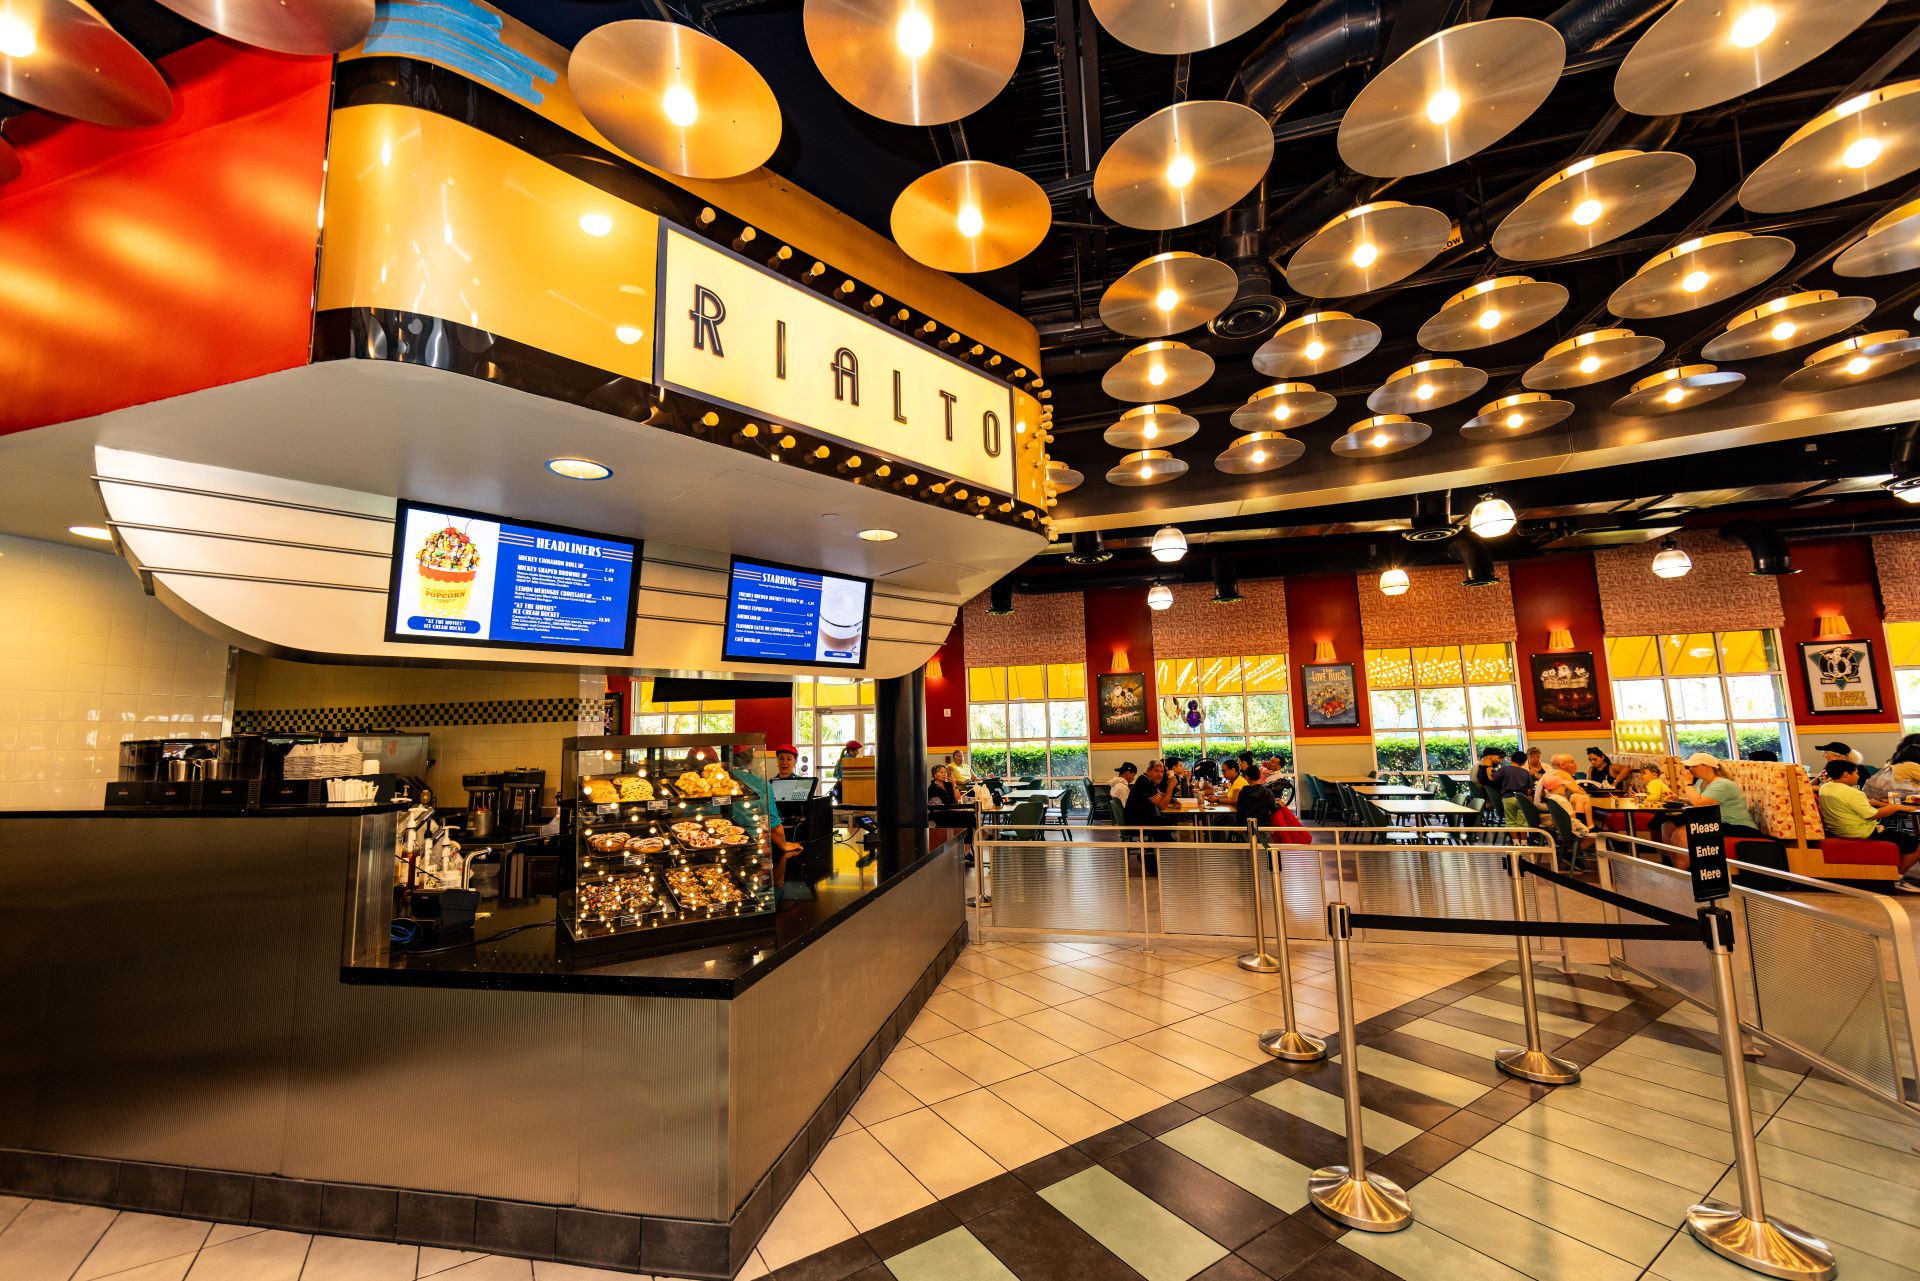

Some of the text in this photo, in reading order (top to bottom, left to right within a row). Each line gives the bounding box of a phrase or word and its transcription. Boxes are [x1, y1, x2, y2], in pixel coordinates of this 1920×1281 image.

[689, 284, 1001, 458] RIALTO
[536, 537, 602, 558] HEADLINERS
[518, 555, 537, 563] MICKEY
[538, 557, 565, 566] CINNAMON
[558, 570, 581, 578] BROWNIE
[762, 573, 796, 586] STARRING
[515, 585, 533, 593] LEMON
[534, 587, 560, 596] MERINGUE
[560, 590, 586, 599] CROISSANT
[1312, 669, 1346, 681] LOVE BUGS
[1690, 822, 1719, 834] Please
[1696, 846, 1719, 857] Enter
[1700, 869, 1721, 880] Here
